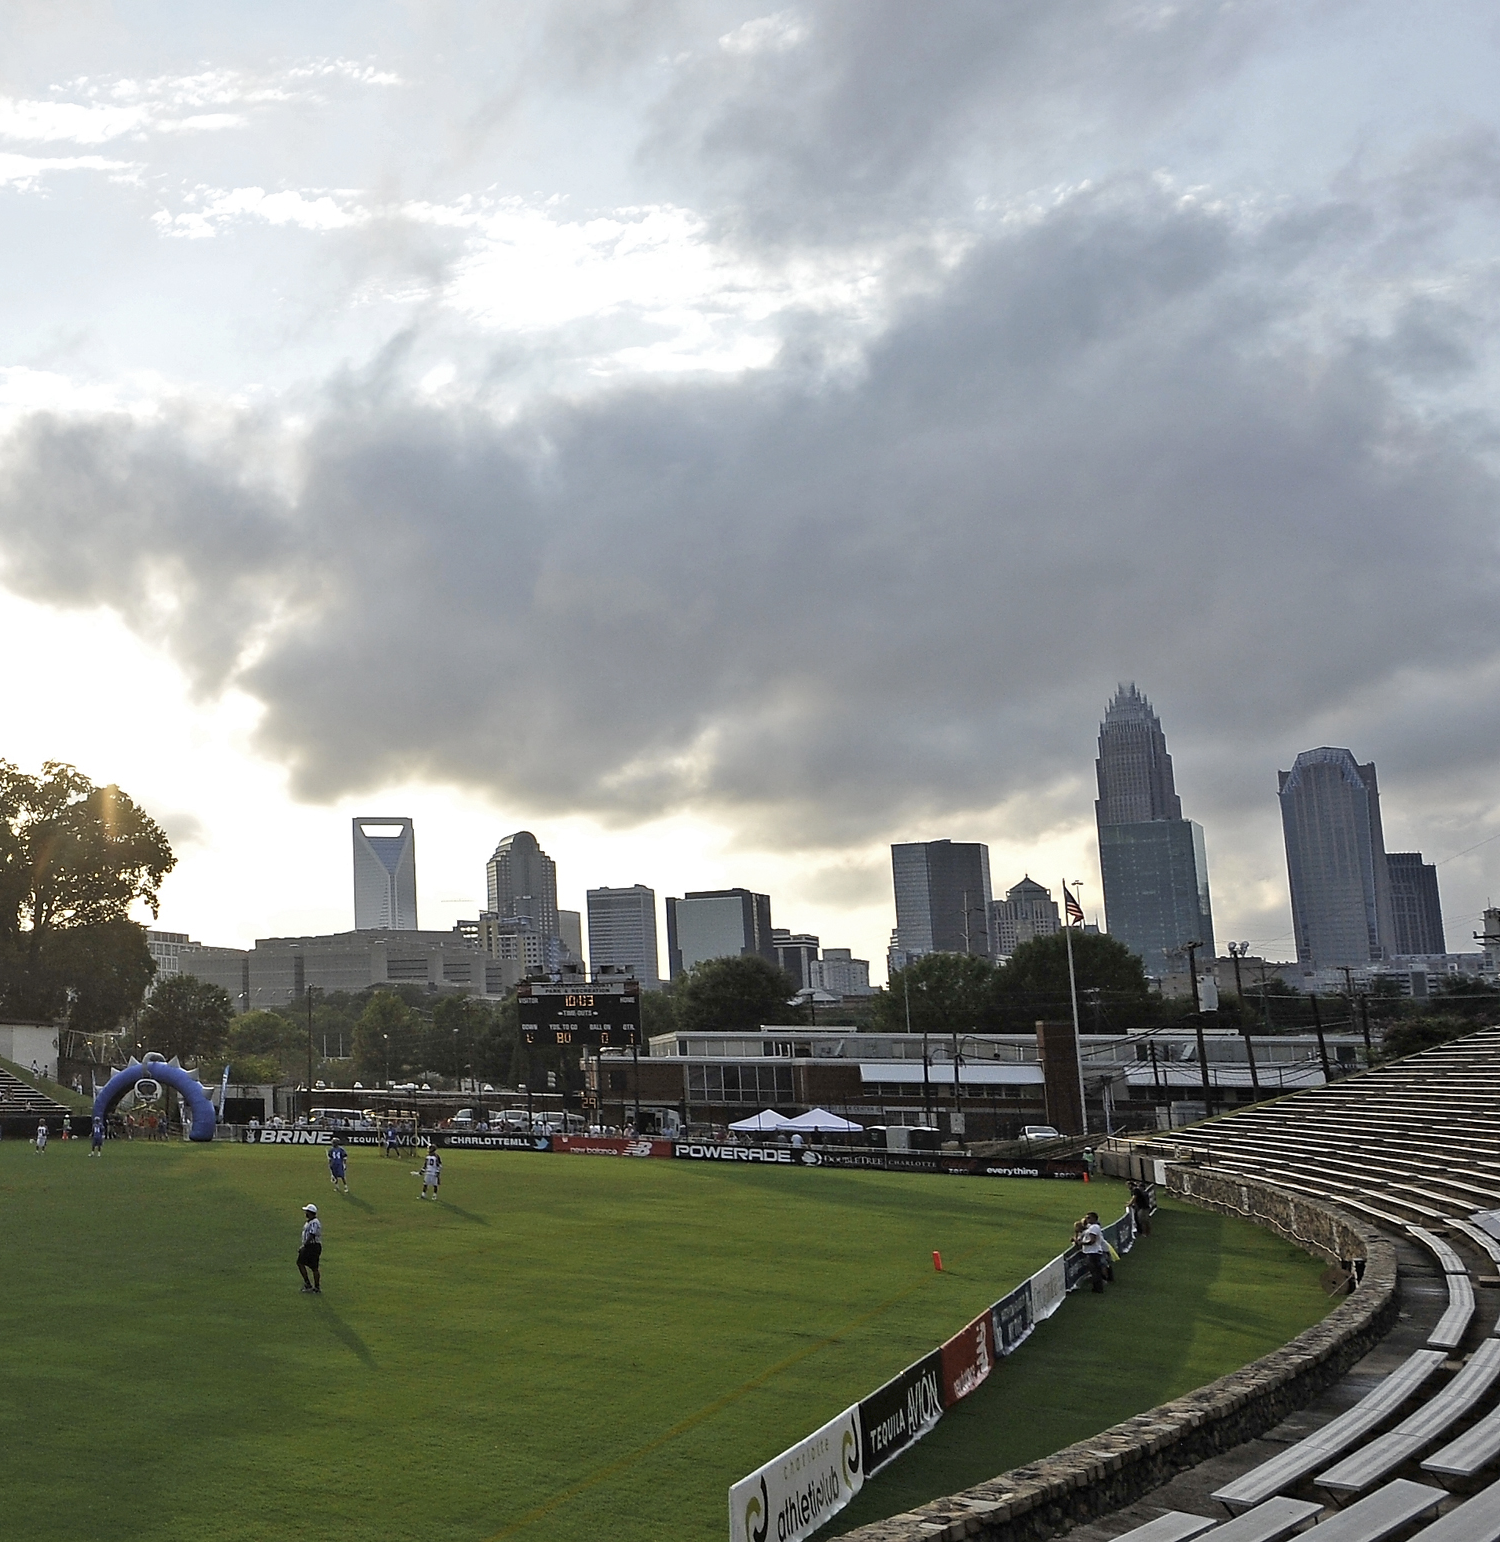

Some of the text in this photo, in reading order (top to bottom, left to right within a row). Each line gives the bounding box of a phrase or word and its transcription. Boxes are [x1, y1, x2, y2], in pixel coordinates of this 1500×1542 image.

[259, 1130, 334, 1144] BRINE
[347, 1136, 386, 1144] TEQUILA
[444, 1136, 530, 1146] @CHARLOTTEMLL
[888, 1160, 937, 1168] CHARLOTTE
[986, 1167, 1039, 1176] everything
[870, 1408, 906, 1454] TEQUILA
